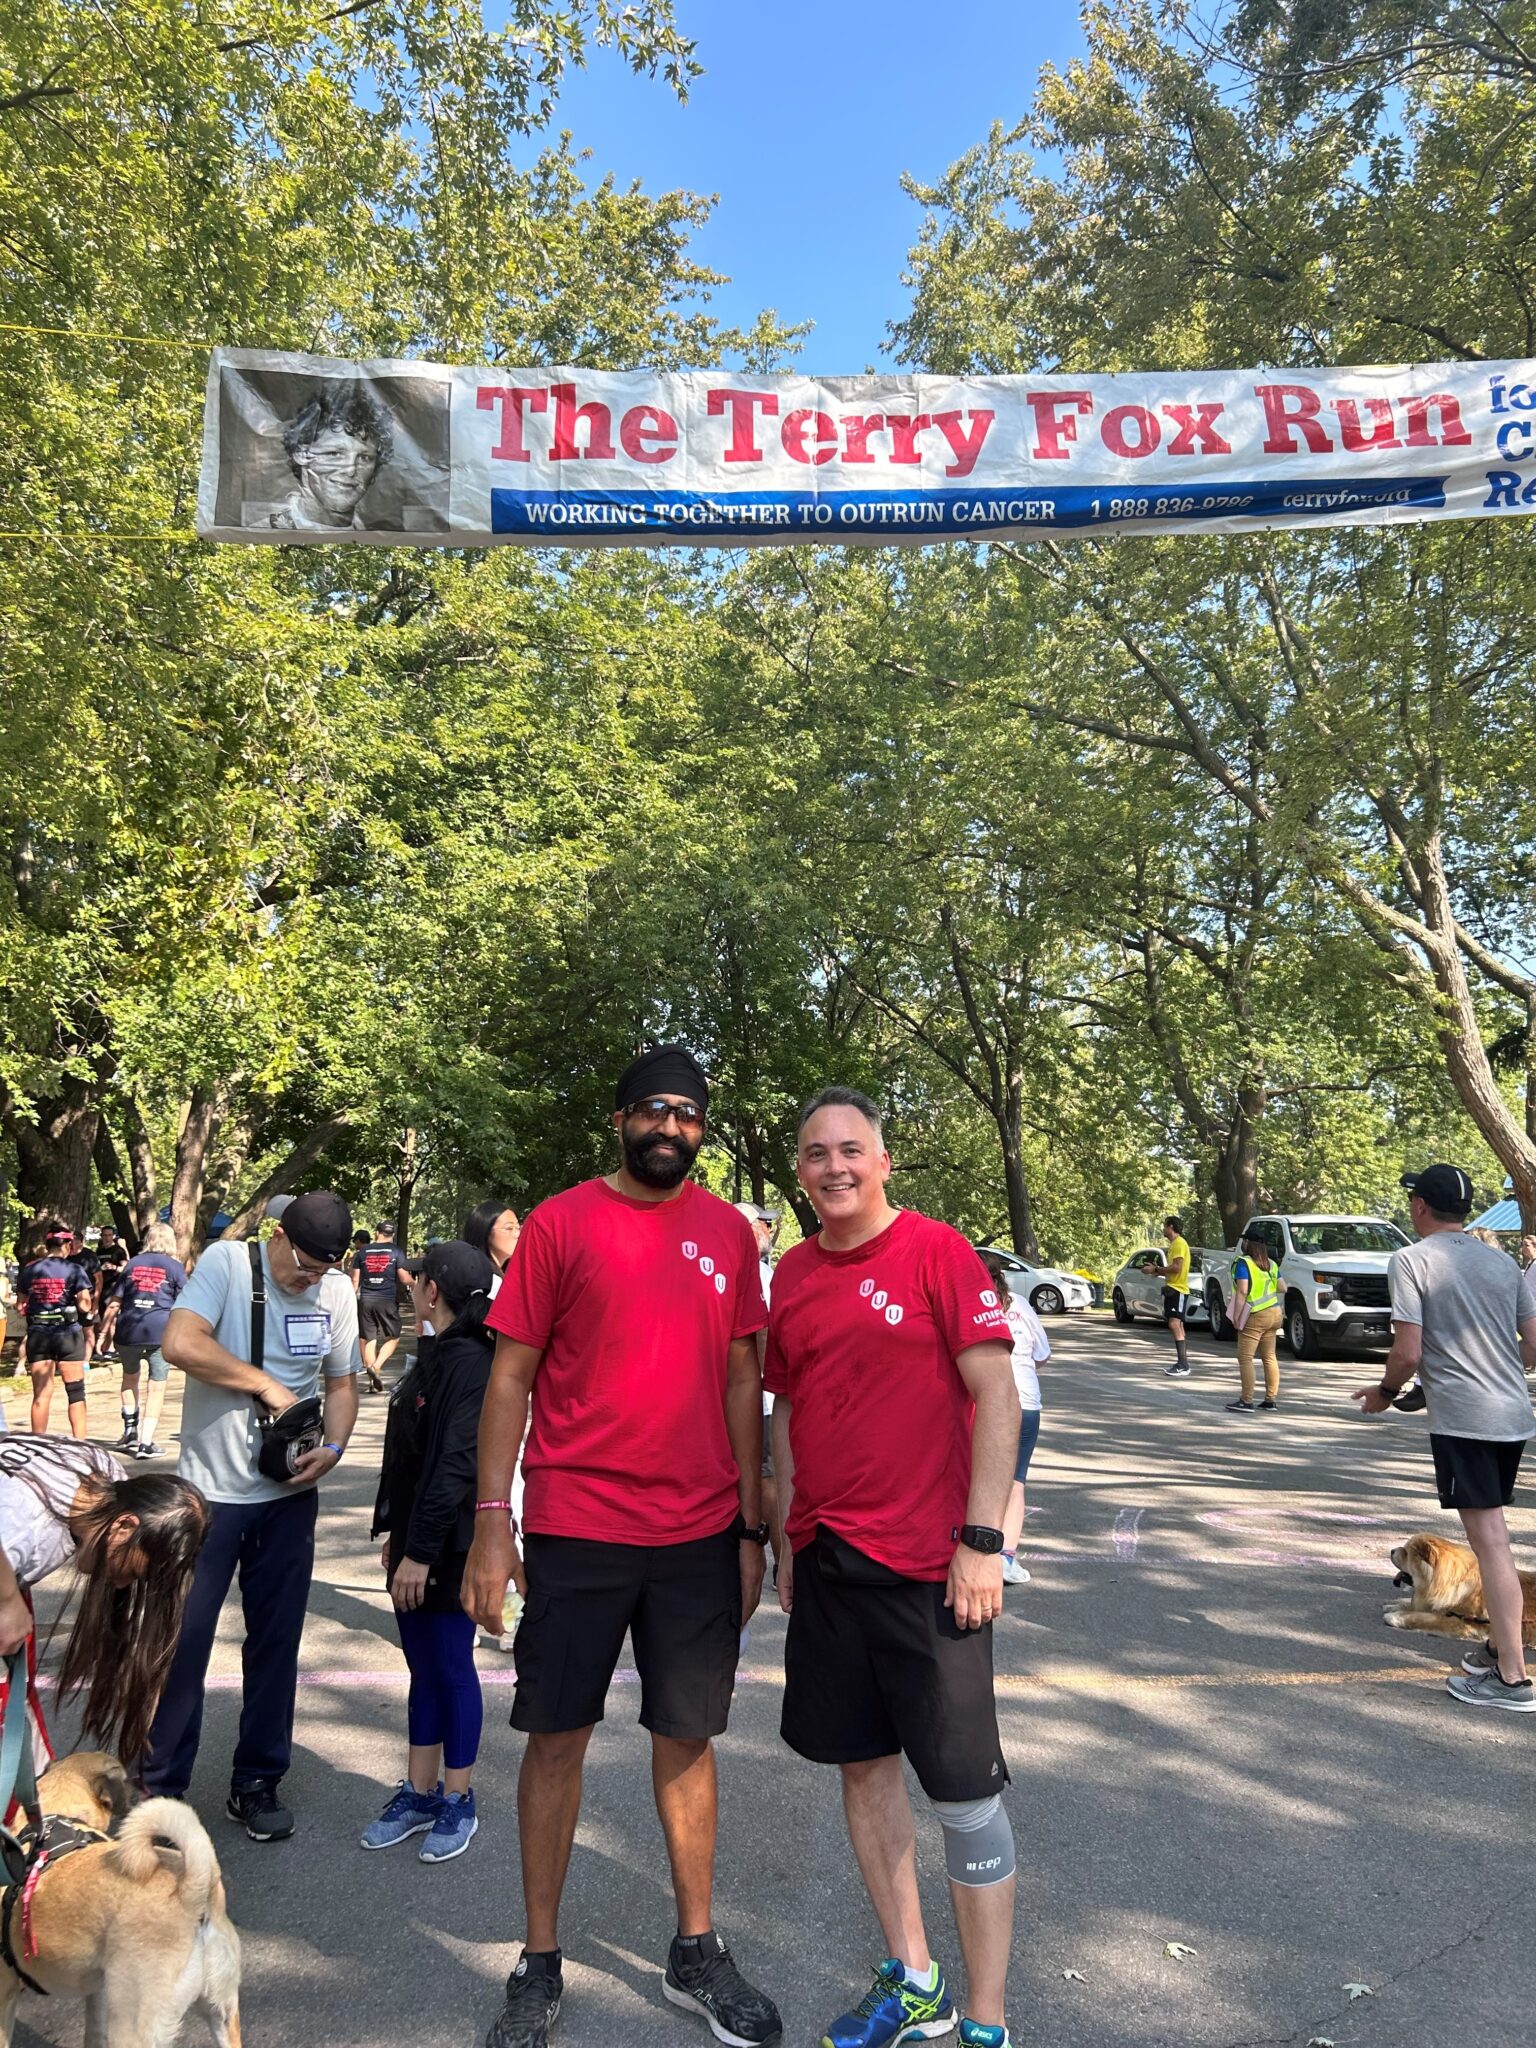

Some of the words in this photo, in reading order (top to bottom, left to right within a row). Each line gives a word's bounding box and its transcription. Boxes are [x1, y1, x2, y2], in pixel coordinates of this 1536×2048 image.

[476, 383, 679, 464] The
[707, 388, 995, 478] Terry
[1026, 391, 1231, 460] Fox
[1254, 384, 1472, 454] Run
[1496, 421, 1536, 462] C
[525, 503, 647, 524] WORKING
[654, 504, 791, 525] TOGETHER
[798, 503, 833, 524] TO
[840, 502, 945, 524] OUTRUN
[952, 500, 1056, 522] CANCER
[1091, 499, 1100, 518] 1
[1109, 498, 1148, 518] 888
